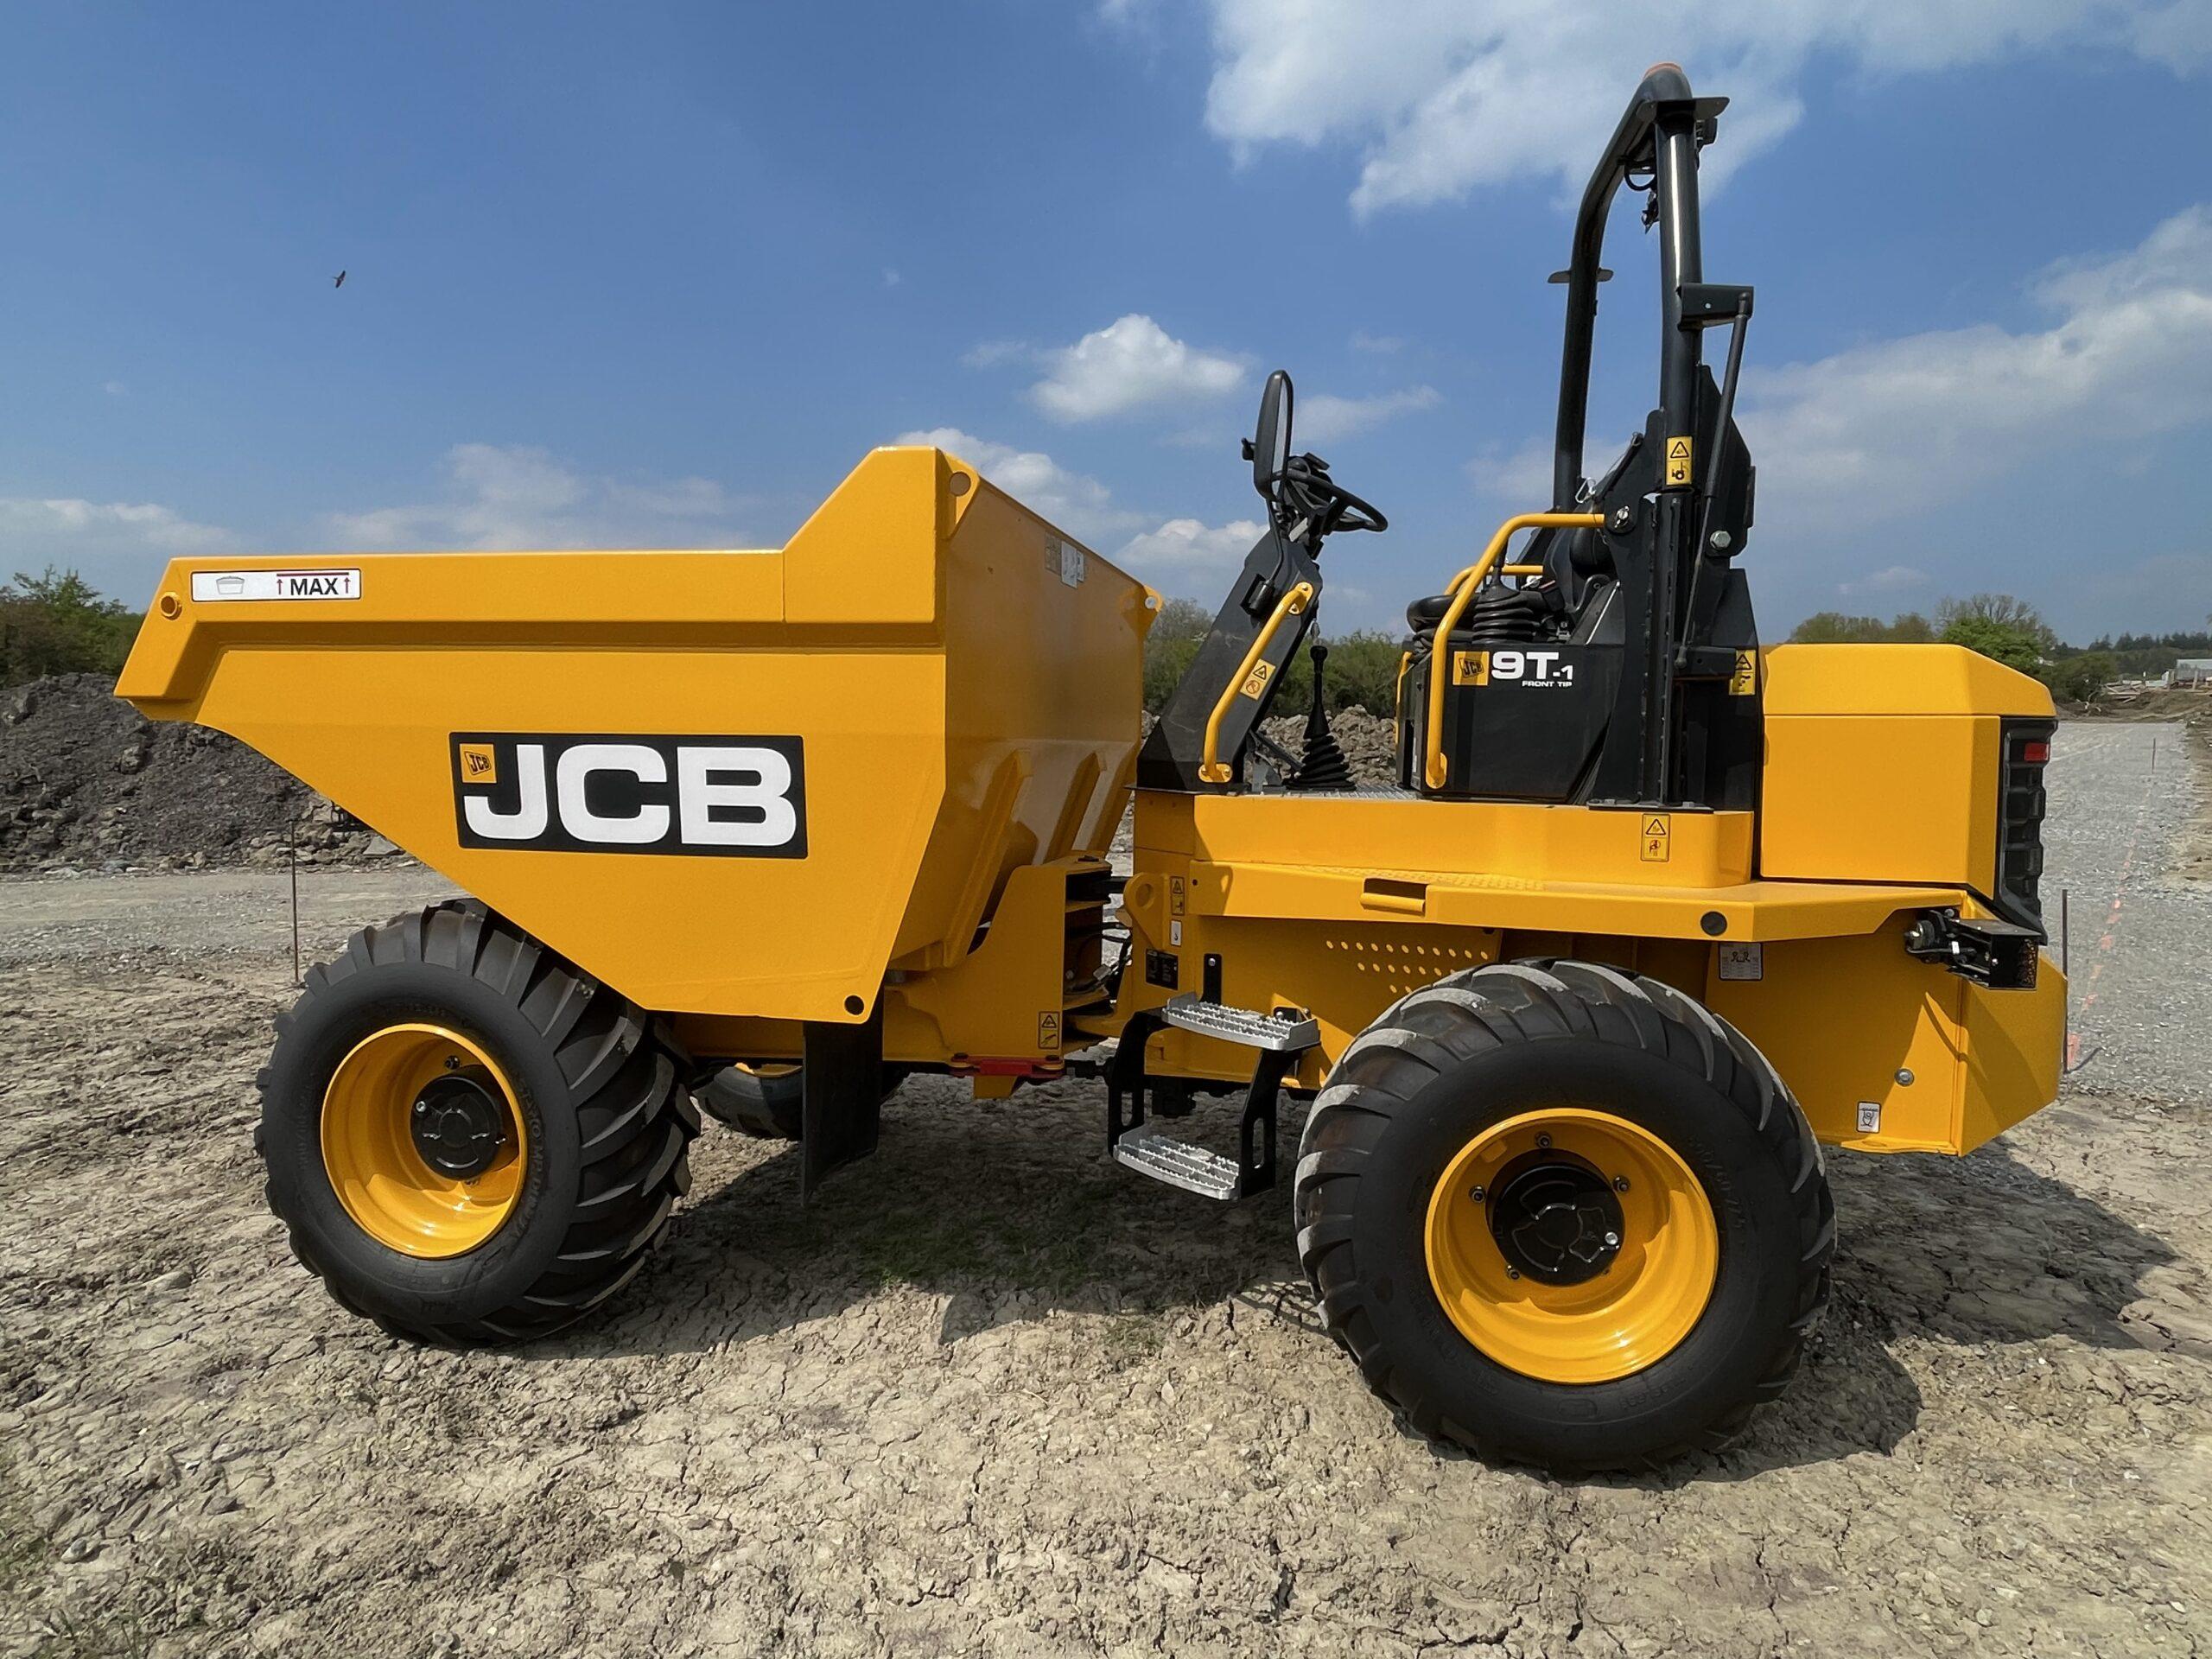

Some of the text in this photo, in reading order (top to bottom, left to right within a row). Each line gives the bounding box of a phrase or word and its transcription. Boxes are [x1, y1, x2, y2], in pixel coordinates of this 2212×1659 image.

[289, 577, 339, 596] MAX
[1462, 659, 1484, 677] JCB
[1522, 679, 1554, 688] FRONT
[468, 753, 490, 772] JCB
[463, 743, 797, 846] JCB
